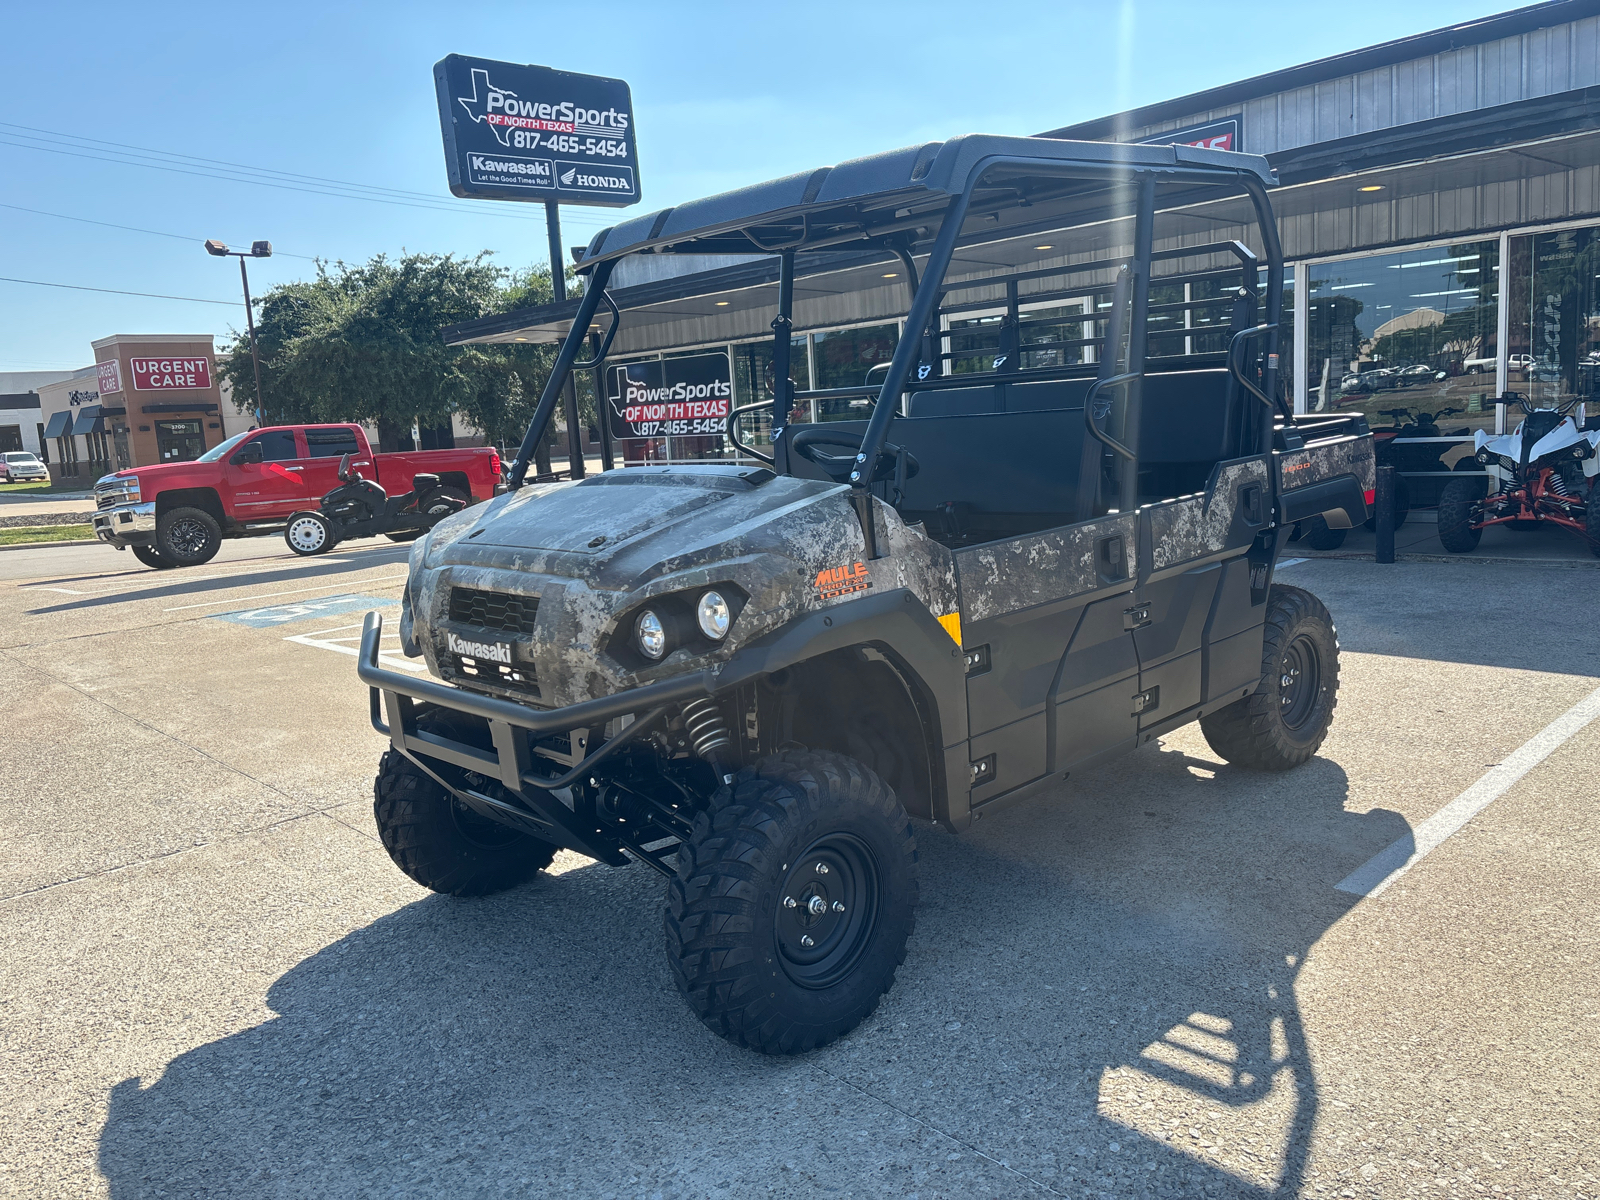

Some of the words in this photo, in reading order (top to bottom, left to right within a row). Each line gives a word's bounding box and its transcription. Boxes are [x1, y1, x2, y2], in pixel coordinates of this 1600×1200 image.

[487, 92, 628, 128] PowerSports
[488, 114, 502, 124] OF
[504, 116, 540, 129] NORTH
[541, 121, 573, 132] TEXAS
[514, 131, 627, 158] 817-465-5454
[472, 156, 550, 176] Kawasaki
[477, 173, 488, 181] Let
[500, 175, 517, 184] Good
[518, 176, 535, 184] Times
[577, 174, 630, 190] HONDA
[97, 363, 118, 380] URGENT
[136, 360, 205, 374] URGENT
[102, 376, 117, 392] CARE
[150, 374, 197, 387] CARE
[626, 379, 731, 403] PowerSports
[626, 406, 642, 421] OF
[686, 400, 727, 417] TEXAS
[641, 418, 727, 436] 817-465-5454
[1285, 462, 1311, 473] 1000
[814, 562, 869, 587] MULE
[819, 582, 843, 592] PRO
[846, 577, 864, 586] FXT
[820, 583, 868, 600] 1000
[448, 633, 511, 663] Kawasaki
